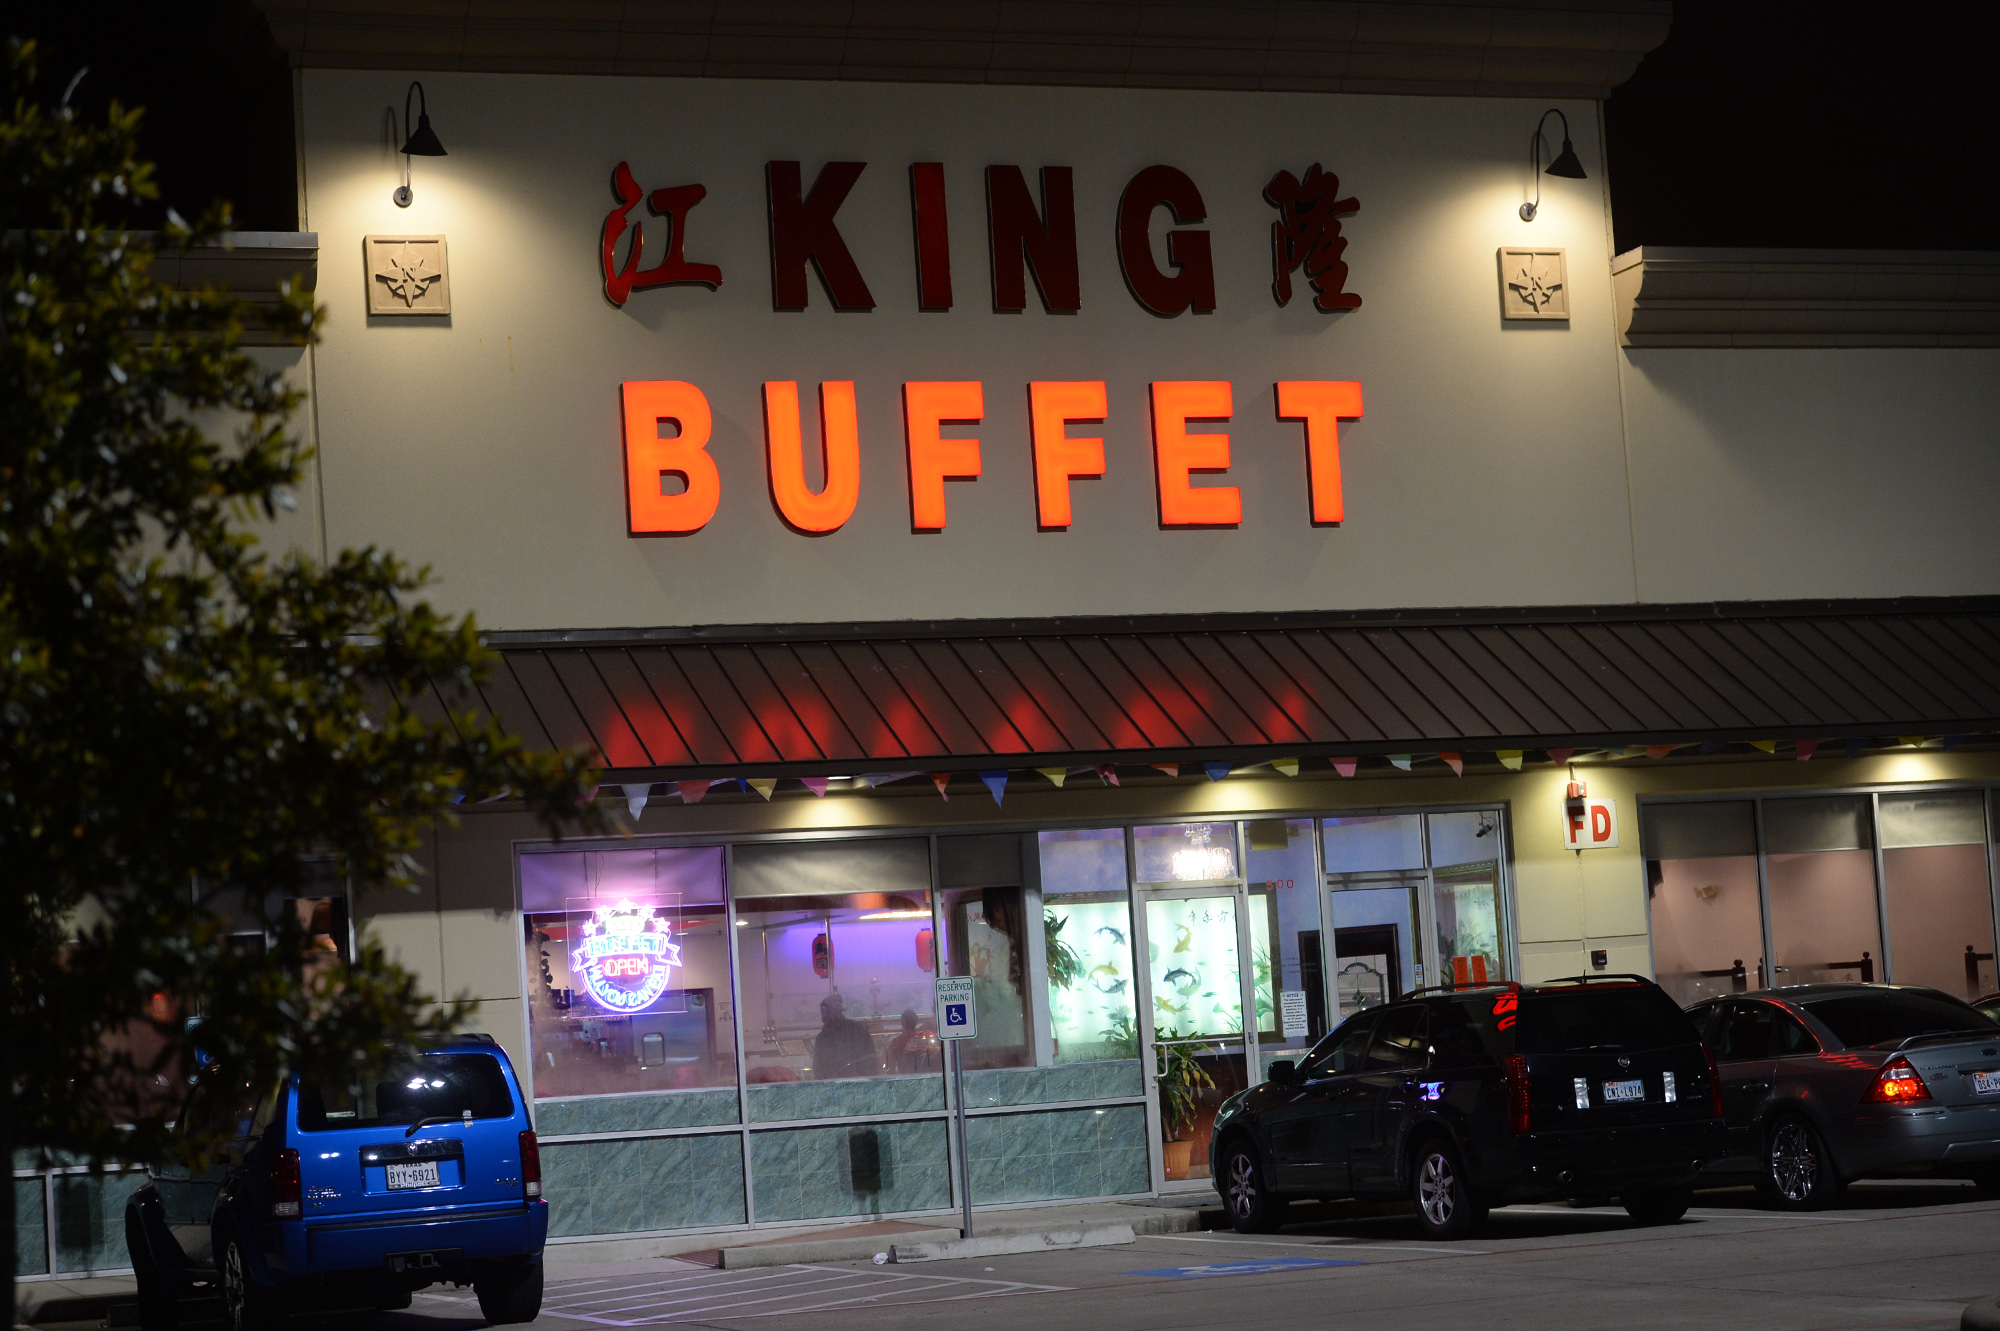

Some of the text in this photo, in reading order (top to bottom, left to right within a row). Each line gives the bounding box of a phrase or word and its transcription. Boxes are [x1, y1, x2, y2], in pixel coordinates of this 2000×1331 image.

[602, 160, 724, 309] 江
[765, 160, 1217, 318] KING
[621, 380, 1363, 536] BUFFET
[1567, 805, 1611, 843] FD
[1266, 880, 1294, 890] 500
[603, 957, 649, 977] OPEN
[938, 983, 972, 992] RESERVED
[940, 993, 969, 1002] PARKING
